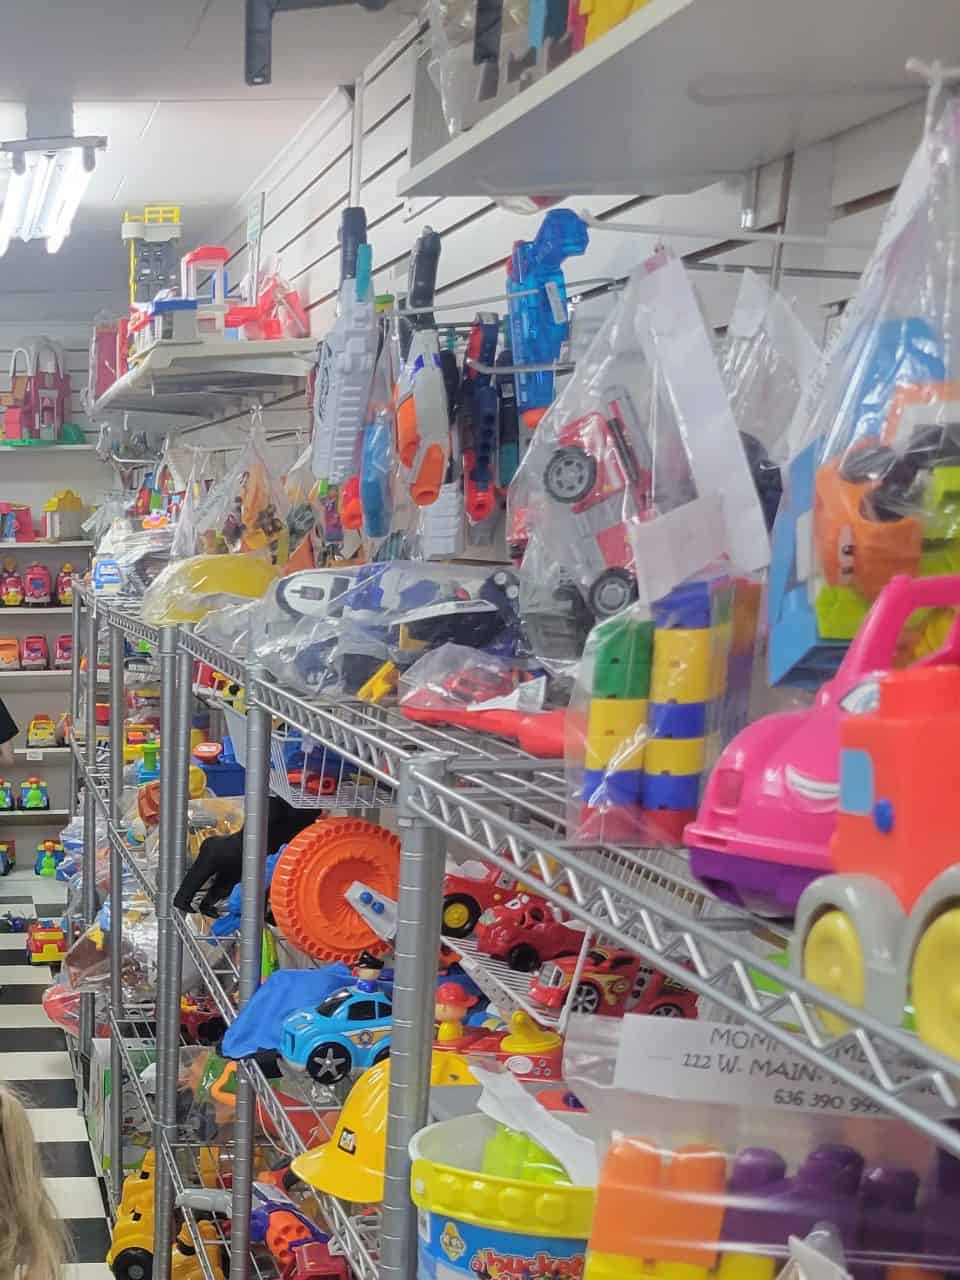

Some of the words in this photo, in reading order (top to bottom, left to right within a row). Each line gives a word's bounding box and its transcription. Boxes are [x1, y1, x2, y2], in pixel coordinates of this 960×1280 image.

[773, 1087, 803, 1106] 636
[807, 1092, 843, 1110] 390
[486, 1250, 585, 1277] bucket
